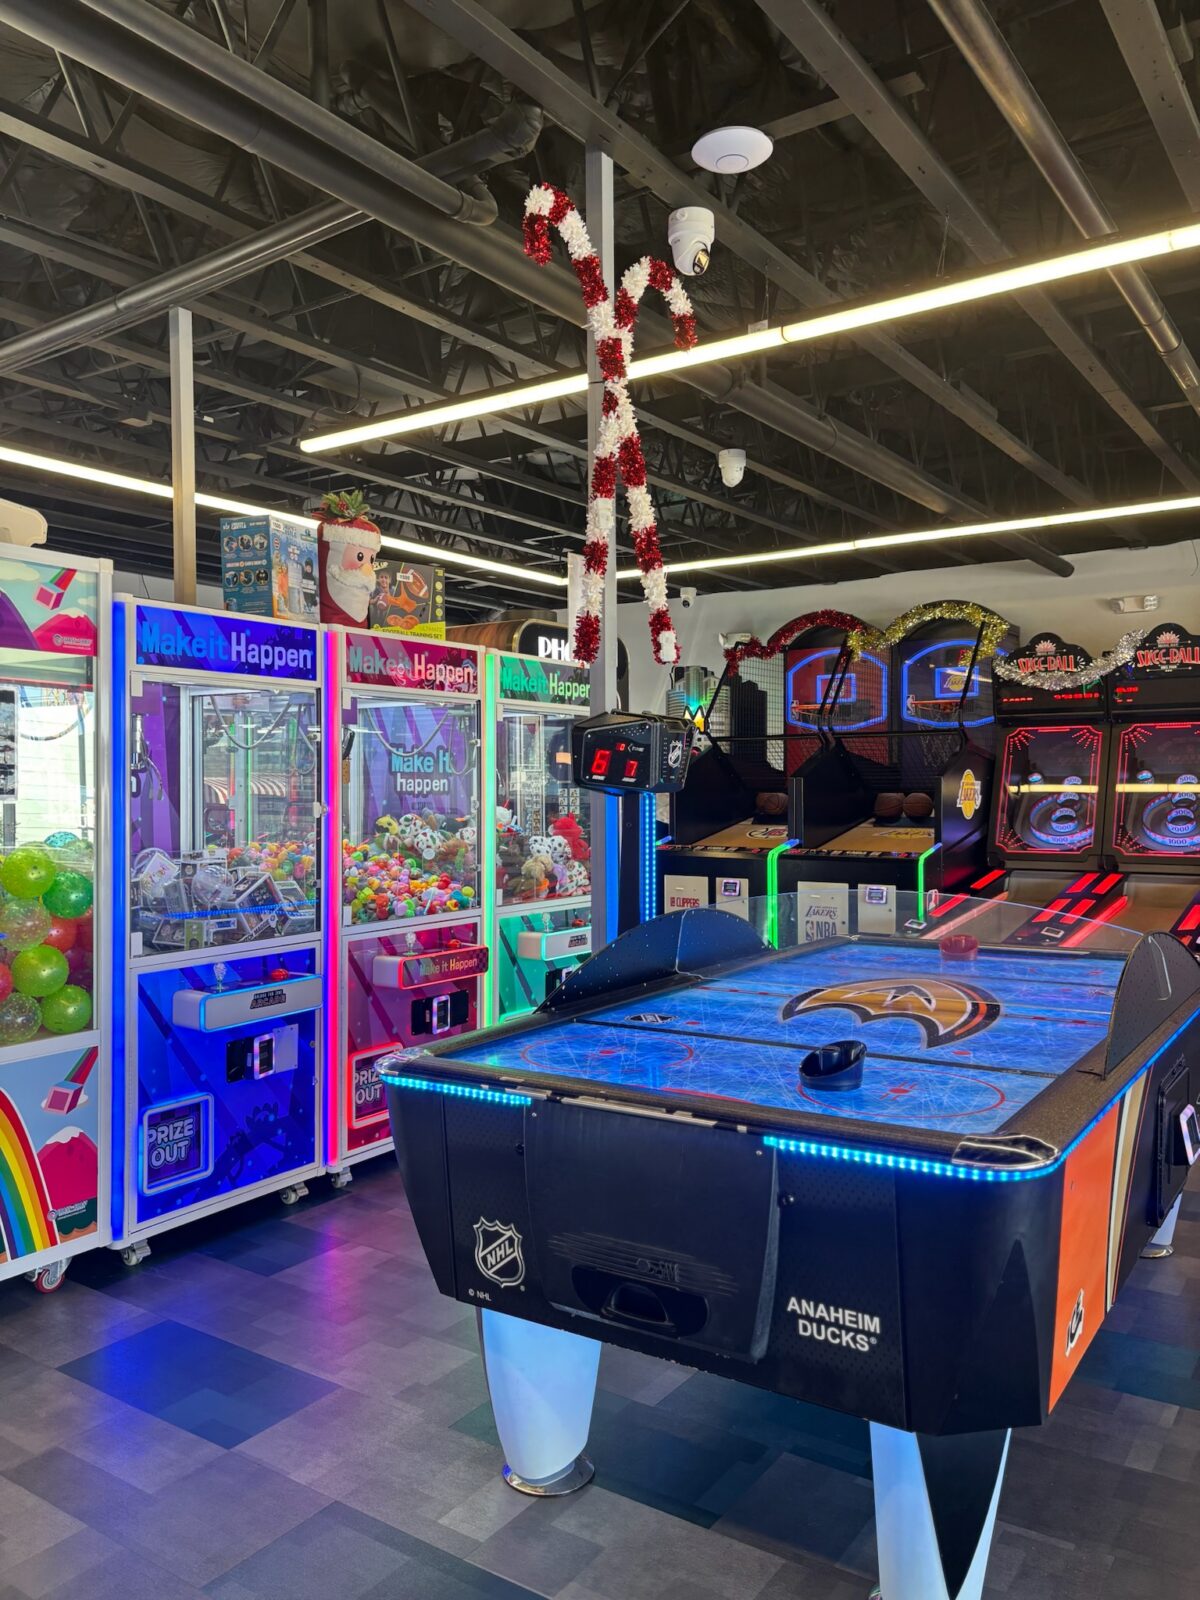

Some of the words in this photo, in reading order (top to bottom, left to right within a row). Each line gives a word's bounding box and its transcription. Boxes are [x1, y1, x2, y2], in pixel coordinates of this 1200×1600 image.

[142, 621, 208, 658] Make
[209, 630, 229, 661] it
[230, 631, 312, 671] Happen
[349, 646, 396, 674] Make
[414, 653, 474, 685] Happen
[503, 667, 537, 692] Make
[392, 748, 434, 773] Make
[591, 749, 612, 775] 6
[396, 772, 448, 794] happen
[815, 920, 838, 940] NBA
[441, 961, 448, 972] it
[449, 959, 478, 971] Happen
[355, 1083, 383, 1105] OUT
[148, 1118, 194, 1145] PRIZE
[151, 1140, 189, 1167] OUT
[486, 1240, 513, 1269] NHL
[476, 1290, 492, 1301] NHL
[787, 1296, 880, 1334] ANAHEIM
